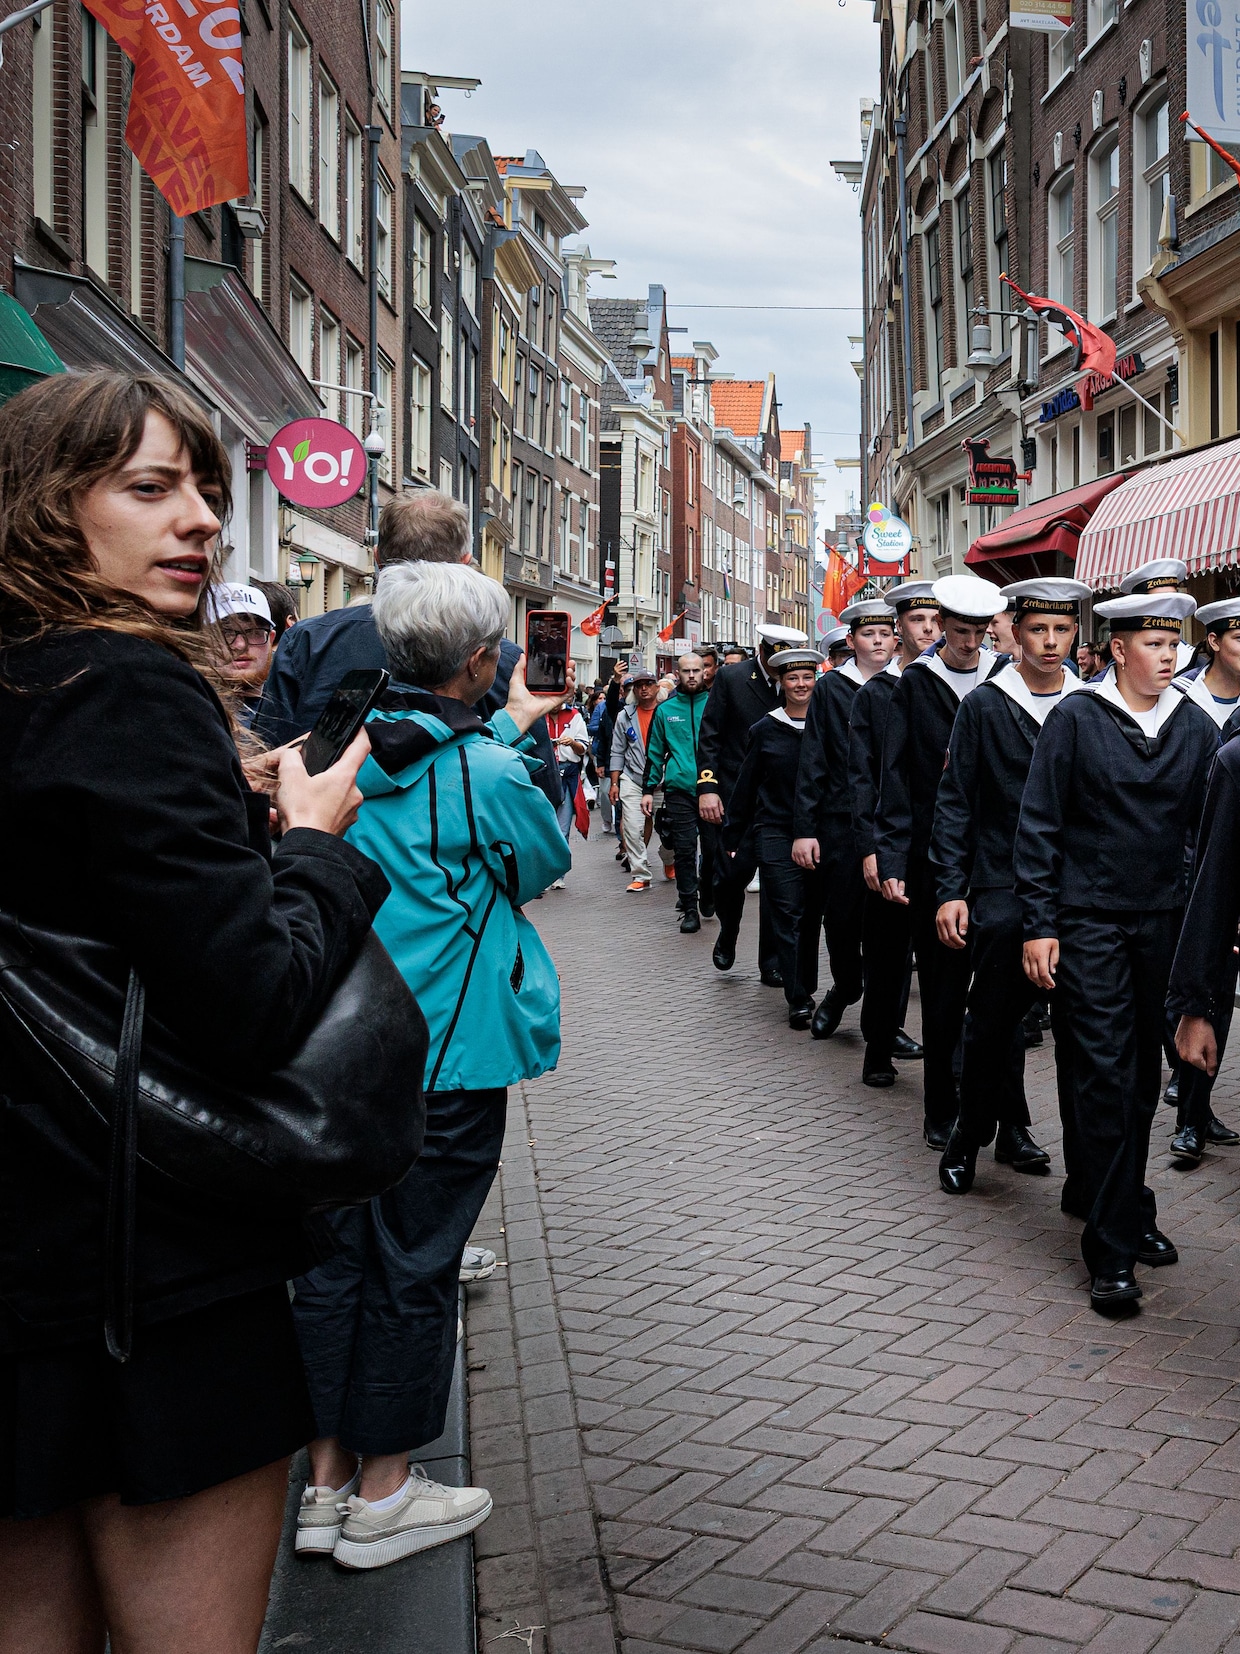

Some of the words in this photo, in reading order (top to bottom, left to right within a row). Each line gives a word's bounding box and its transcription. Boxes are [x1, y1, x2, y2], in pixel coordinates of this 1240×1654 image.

[145, 0, 212, 88] RDAM
[276, 446, 354, 487] YO!
[971, 493, 1018, 504] RESTAURANT
[871, 527, 903, 540] Sweet
[876, 539, 904, 549] Station
